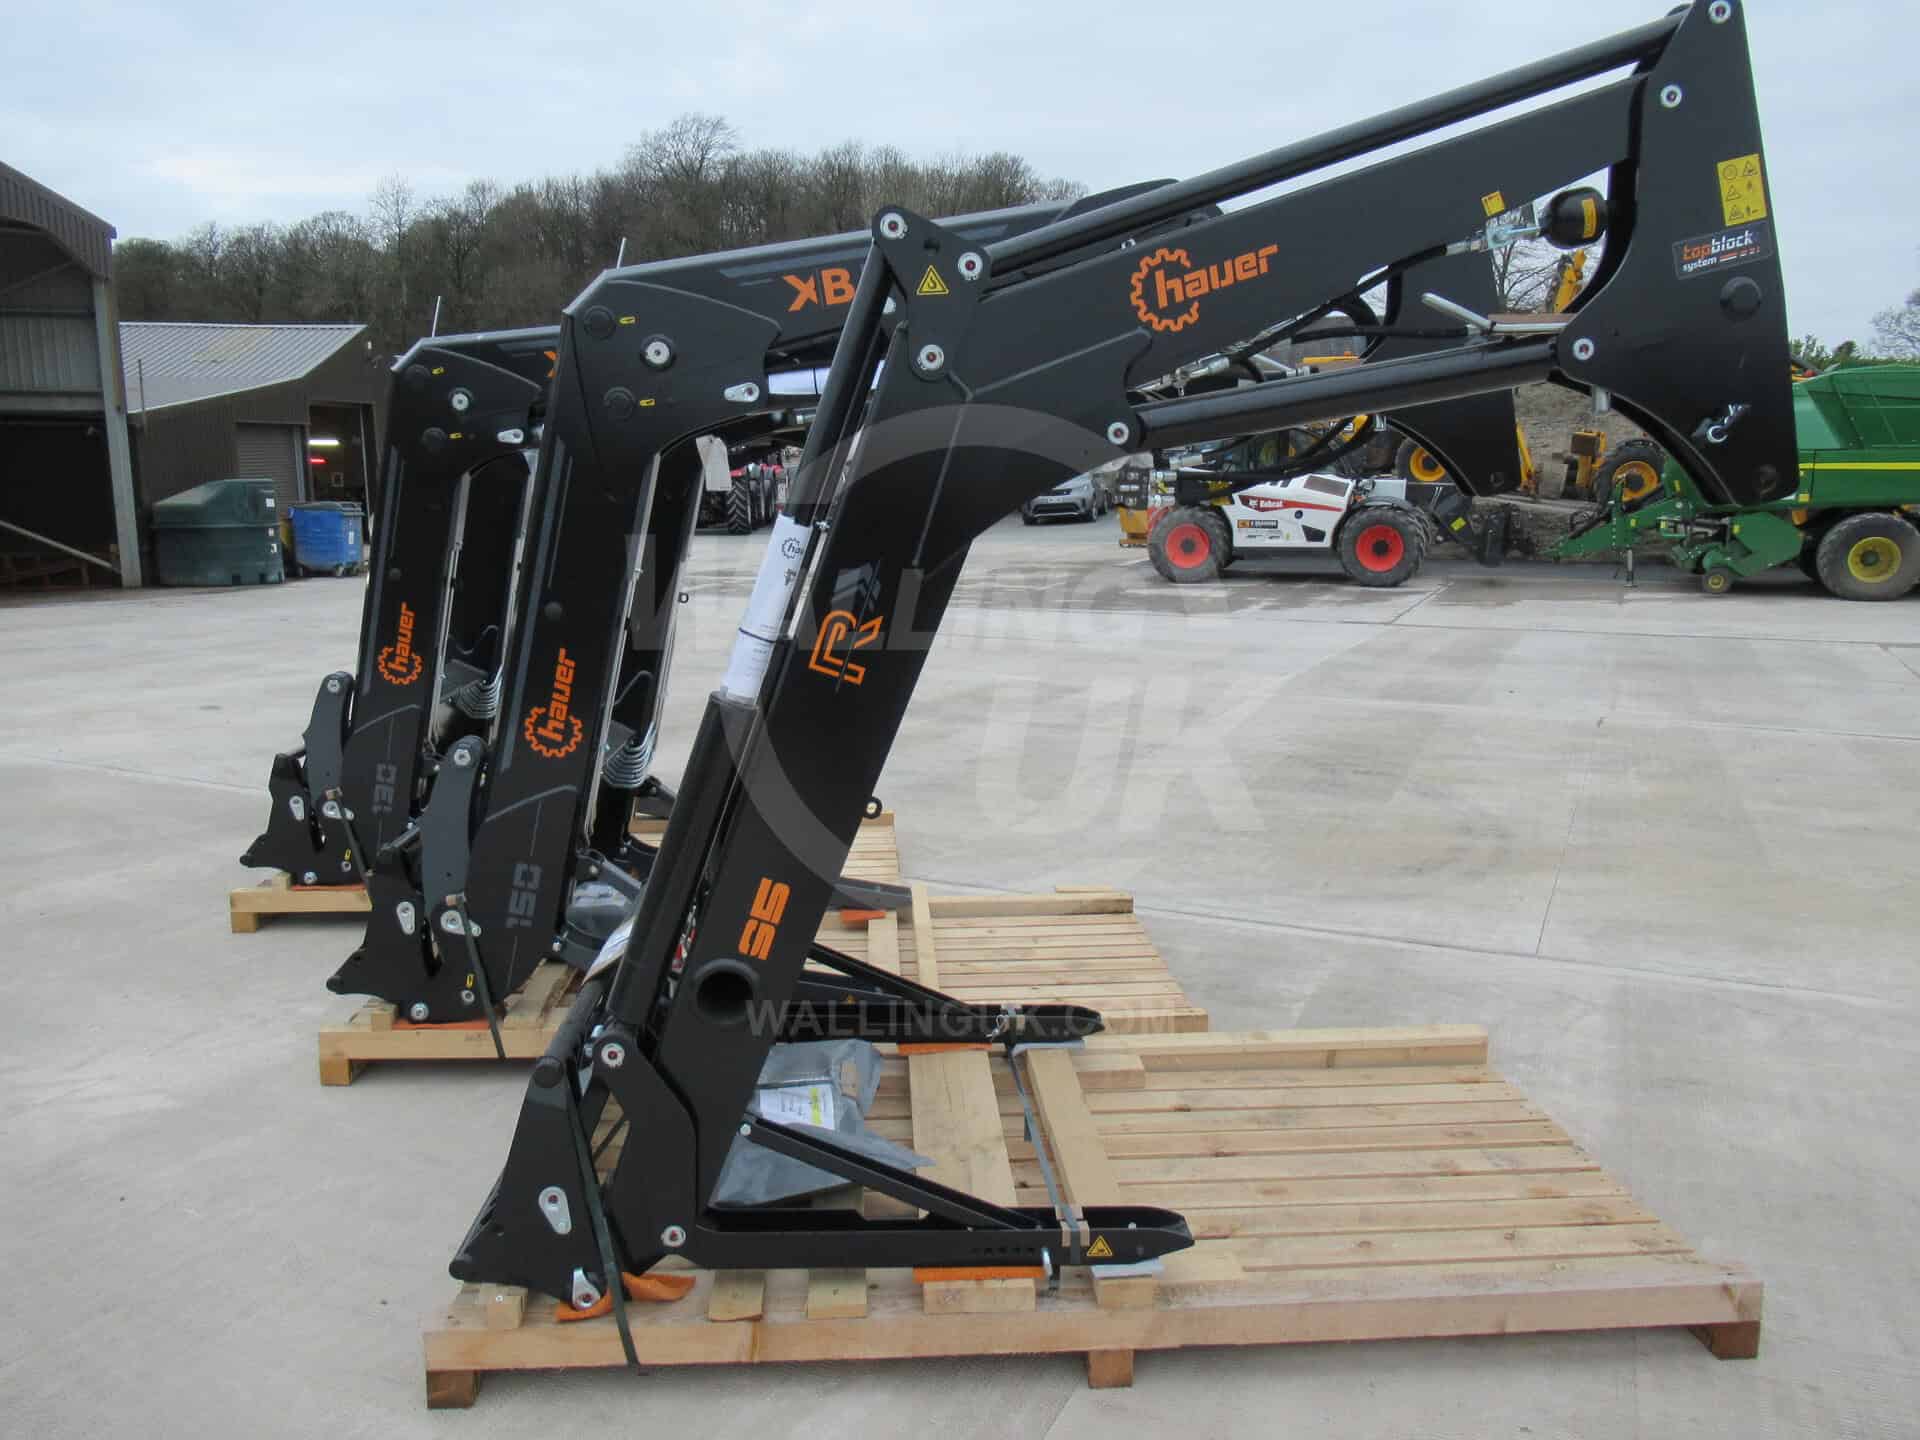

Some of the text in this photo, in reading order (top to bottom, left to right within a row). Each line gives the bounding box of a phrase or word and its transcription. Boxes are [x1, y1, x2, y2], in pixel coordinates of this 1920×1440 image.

[1154, 243, 1280, 309] hauer
[1682, 230, 1754, 260] topblock
[1682, 256, 1718, 272] system
[388, 601, 416, 674] hauer
[537, 647, 578, 743] hauer
[372, 762, 398, 815] 130
[505, 862, 543, 929] 150
[737, 876, 791, 961] S5
